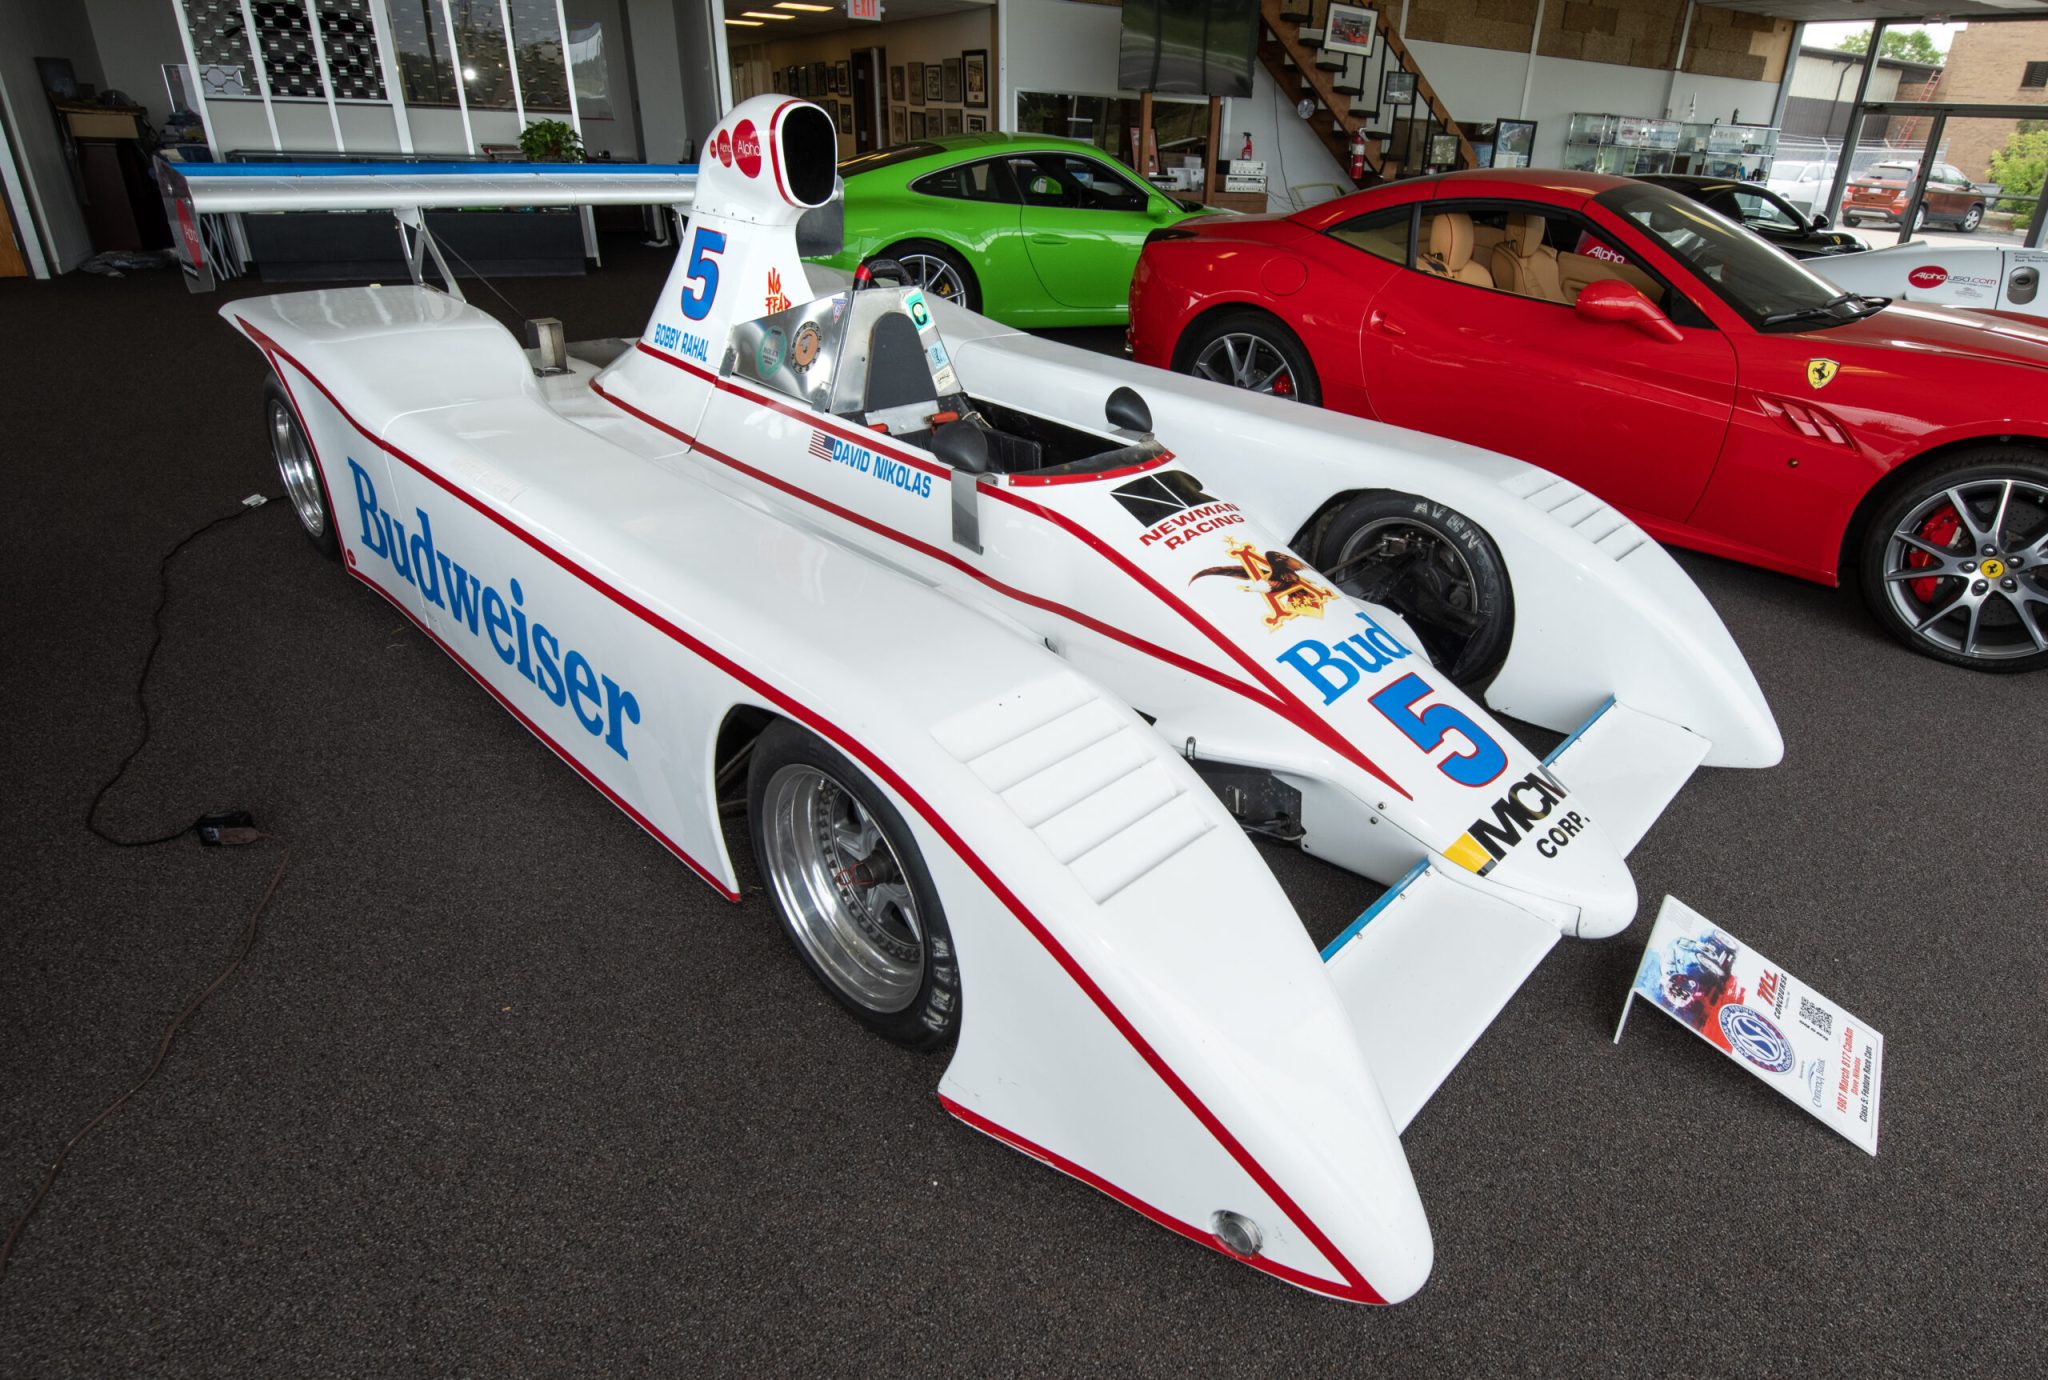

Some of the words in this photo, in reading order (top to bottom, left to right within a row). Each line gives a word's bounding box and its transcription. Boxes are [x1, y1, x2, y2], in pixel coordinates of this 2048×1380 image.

[853, 0, 877, 17] EXIT
[737, 139, 761, 157] Alpha
[1586, 245, 1625, 264] Alpha
[681, 226, 727, 321] 5
[767, 266, 782, 296] NO
[1912, 271, 1947, 281] Alpha
[654, 322, 682, 351] BOBBY
[681, 331, 709, 362] RAHAL
[832, 439, 871, 473] DAVID
[872, 455, 932, 499] NIKOLAS
[1139, 503, 1240, 546] NEWMAN
[1164, 514, 1245, 550] RACING
[347, 456, 641, 761] Budweiser
[1275, 612, 1412, 706] Bud
[1367, 671, 1509, 788] 5
[1536, 810, 1591, 859] CORP.
[1774, 973, 1787, 1019] CONCOURSE
[1843, 1027, 1854, 1053] CanAm
[1864, 1045, 1872, 1059] Cars
[1863, 1058, 1871, 1075] Race
[1839, 1067, 1849, 1093] March
[1851, 1078, 1859, 1096] Dave
[1861, 1074, 1870, 1098] Feature
[1836, 1092, 1847, 1114] 1981
[1859, 1104, 1868, 1123] Class
